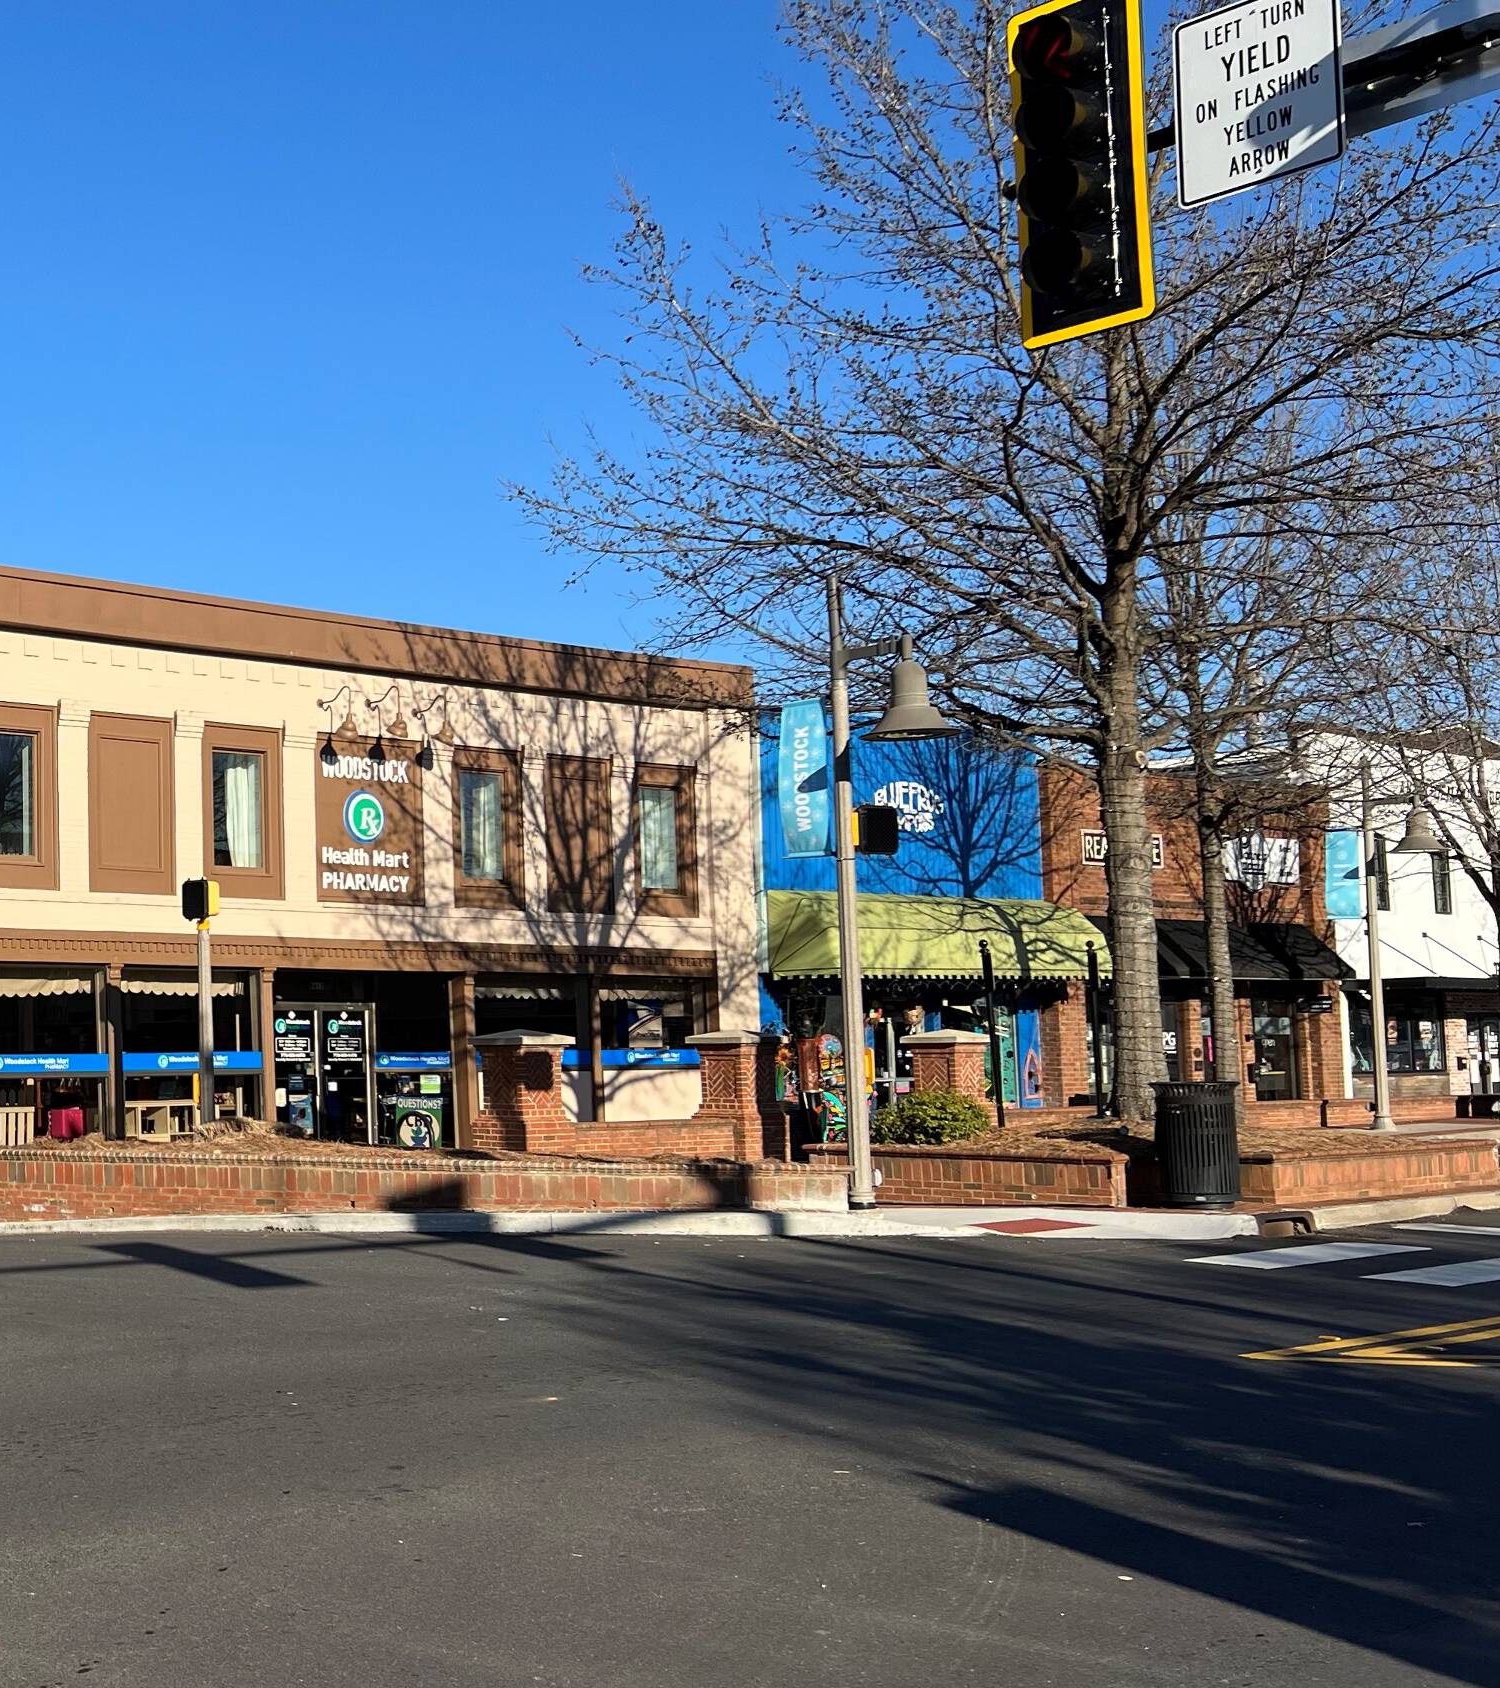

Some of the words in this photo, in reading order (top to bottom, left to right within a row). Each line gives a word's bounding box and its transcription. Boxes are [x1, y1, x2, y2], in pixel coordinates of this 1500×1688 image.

[1204, 18, 1242, 50] LEFT
[1260, 0, 1305, 29] TURN
[1220, 34, 1290, 82] YIELD
[1196, 98, 1218, 124] ON
[1235, 63, 1319, 111] FLASHING
[1223, 104, 1292, 146] YELLOW
[1228, 138, 1290, 178] ARROW
[321, 754, 410, 784] WOODSTOCK
[321, 846, 370, 867] Health
[372, 849, 410, 869] Mart
[322, 871, 410, 893] PHARMACY
[4, 1057, 37, 1065] Woodstock
[398, 1097, 442, 1109] QUESTIONS?
